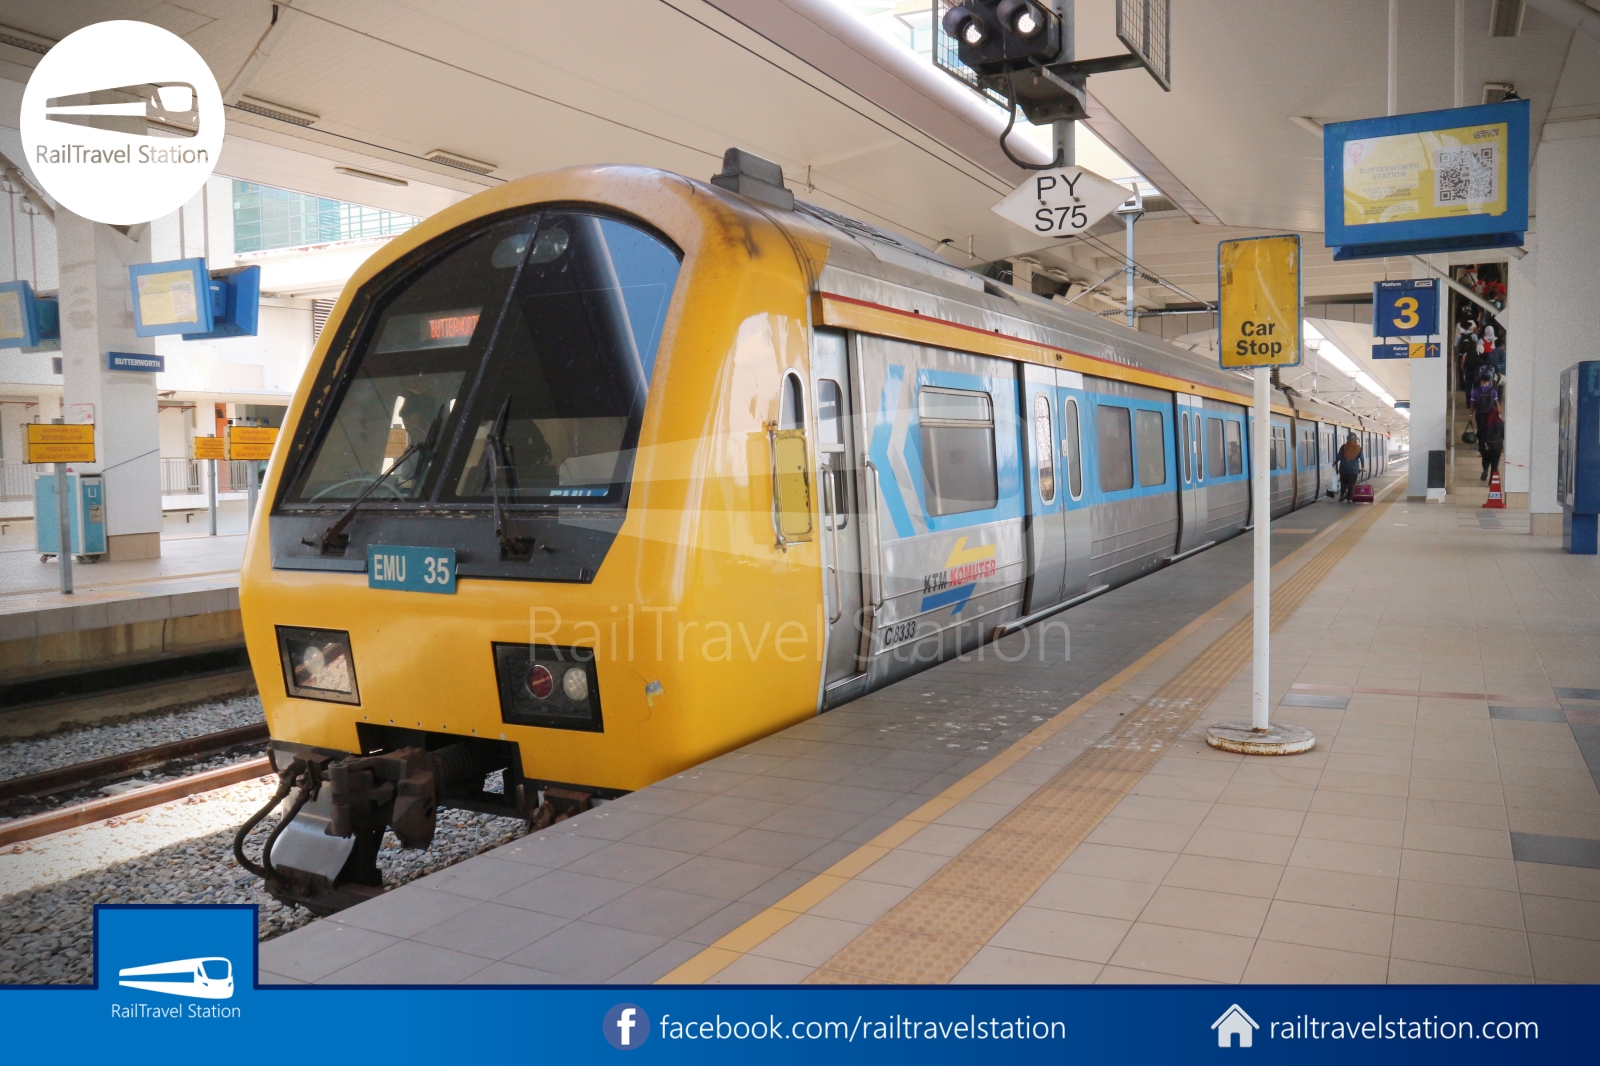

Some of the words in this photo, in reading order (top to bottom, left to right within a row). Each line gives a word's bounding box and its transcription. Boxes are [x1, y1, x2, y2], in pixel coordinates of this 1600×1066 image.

[1359, 163, 1419, 175] BUTTERWORTH
[1372, 171, 1406, 180] STATION
[1036, 172, 1083, 200] PY
[1035, 204, 1088, 232] S75
[1393, 296, 1419, 330] 3
[1241, 320, 1276, 337] Car
[1236, 340, 1282, 358] Stop
[114, 357, 161, 368] BUTTERWORTH
[373, 554, 406, 582] EMU
[423, 556, 450, 585] 35
[923, 570, 948, 594] KTM
[949, 558, 996, 587] KOMUTER
